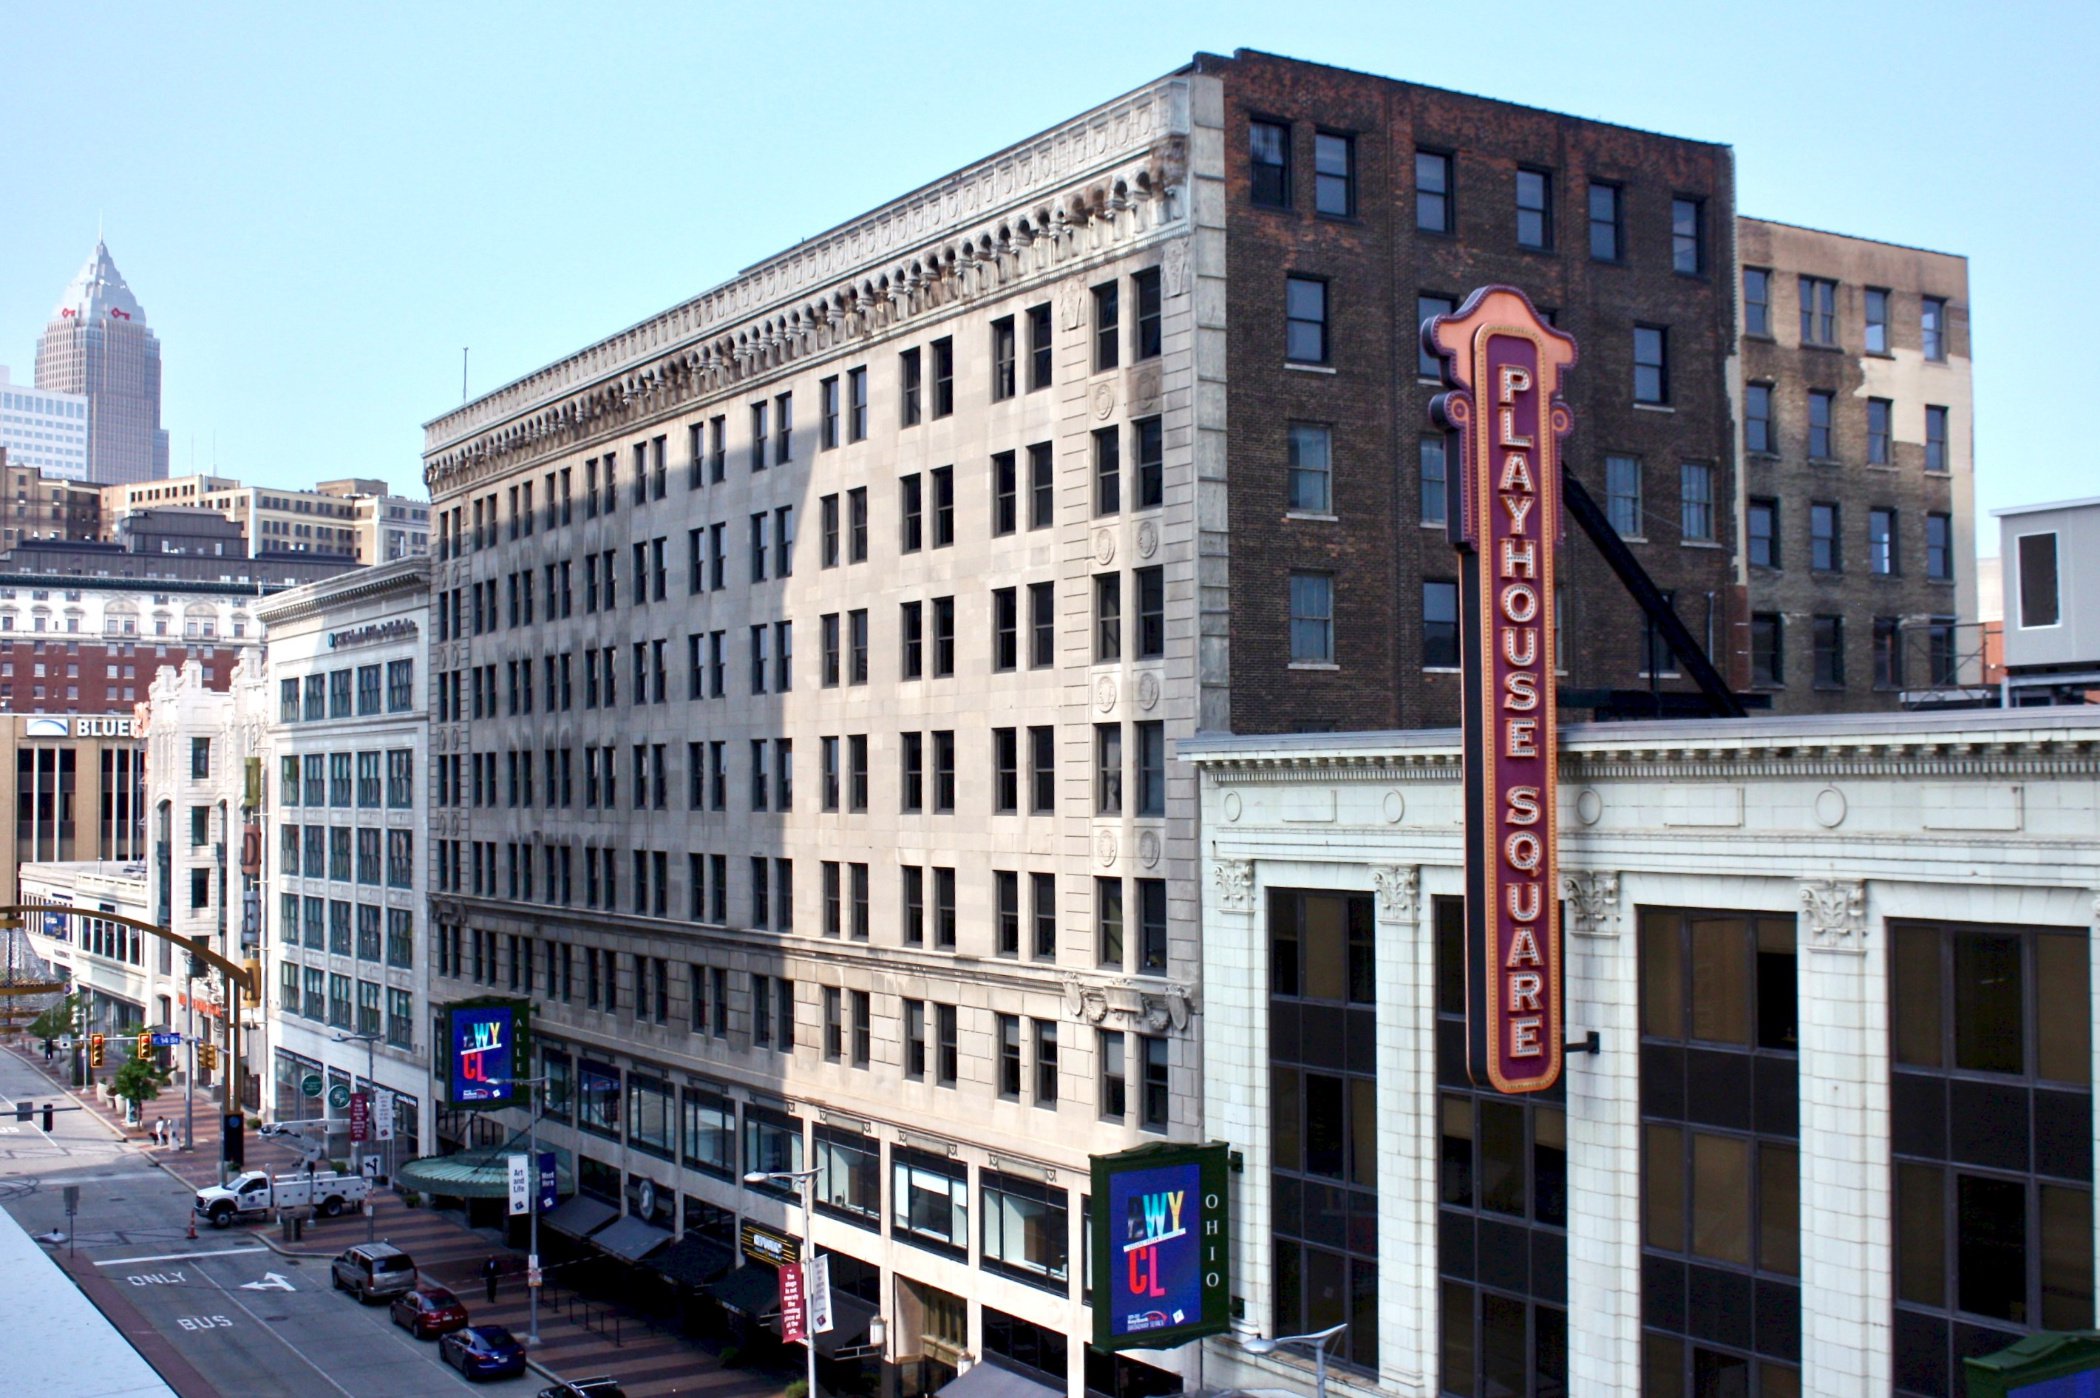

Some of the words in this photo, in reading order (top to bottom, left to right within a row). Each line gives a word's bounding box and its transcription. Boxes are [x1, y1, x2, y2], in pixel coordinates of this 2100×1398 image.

[1498, 363, 1539, 758] PLAYHOUSE
[77, 719, 137, 737] BLUE
[1505, 785, 1544, 1058] SQUARE
[1205, 1194, 1219, 1288] OHIO
[126, 1271, 187, 1287] ONLY
[1128, 1245, 1166, 1298] CL
[177, 1315, 233, 1331] BUS
